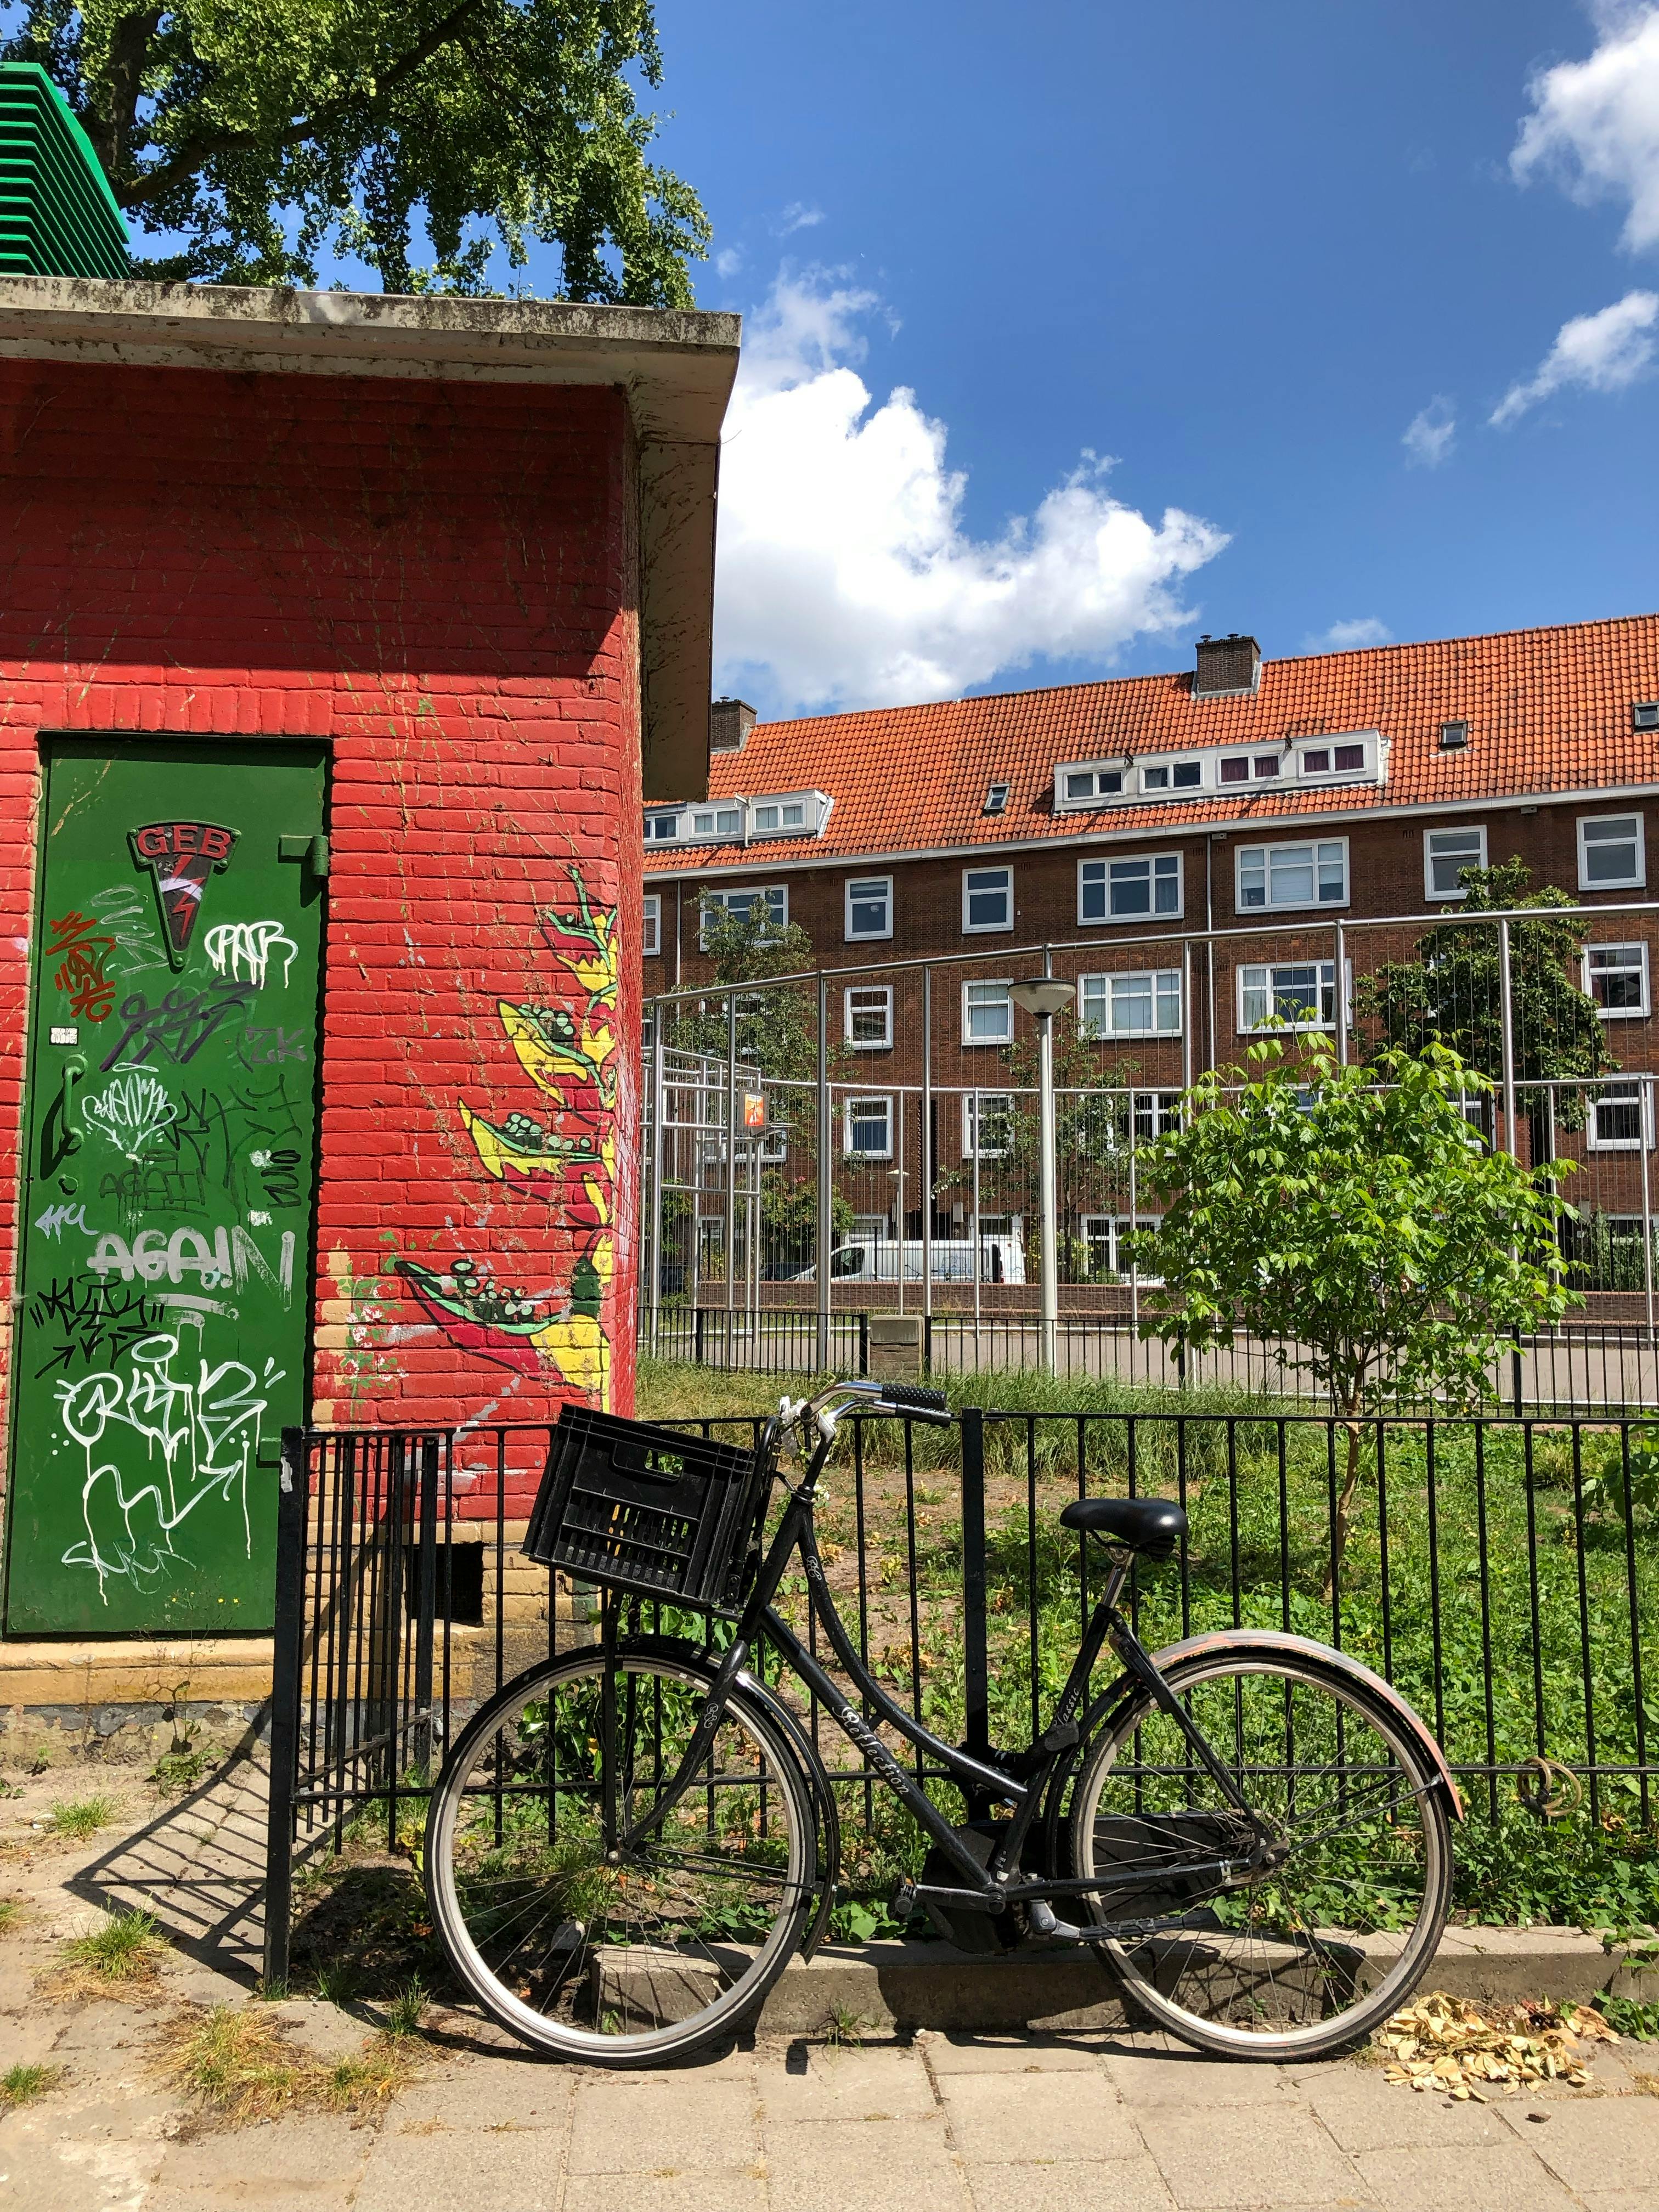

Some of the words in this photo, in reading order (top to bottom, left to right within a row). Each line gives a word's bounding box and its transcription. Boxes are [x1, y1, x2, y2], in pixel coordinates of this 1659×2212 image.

[138, 825, 230, 859] GEB
[86, 1224, 296, 1312] AGAIN
[1053, 1688, 1079, 1726] lassic
[832, 1706, 909, 1795] Reflection
